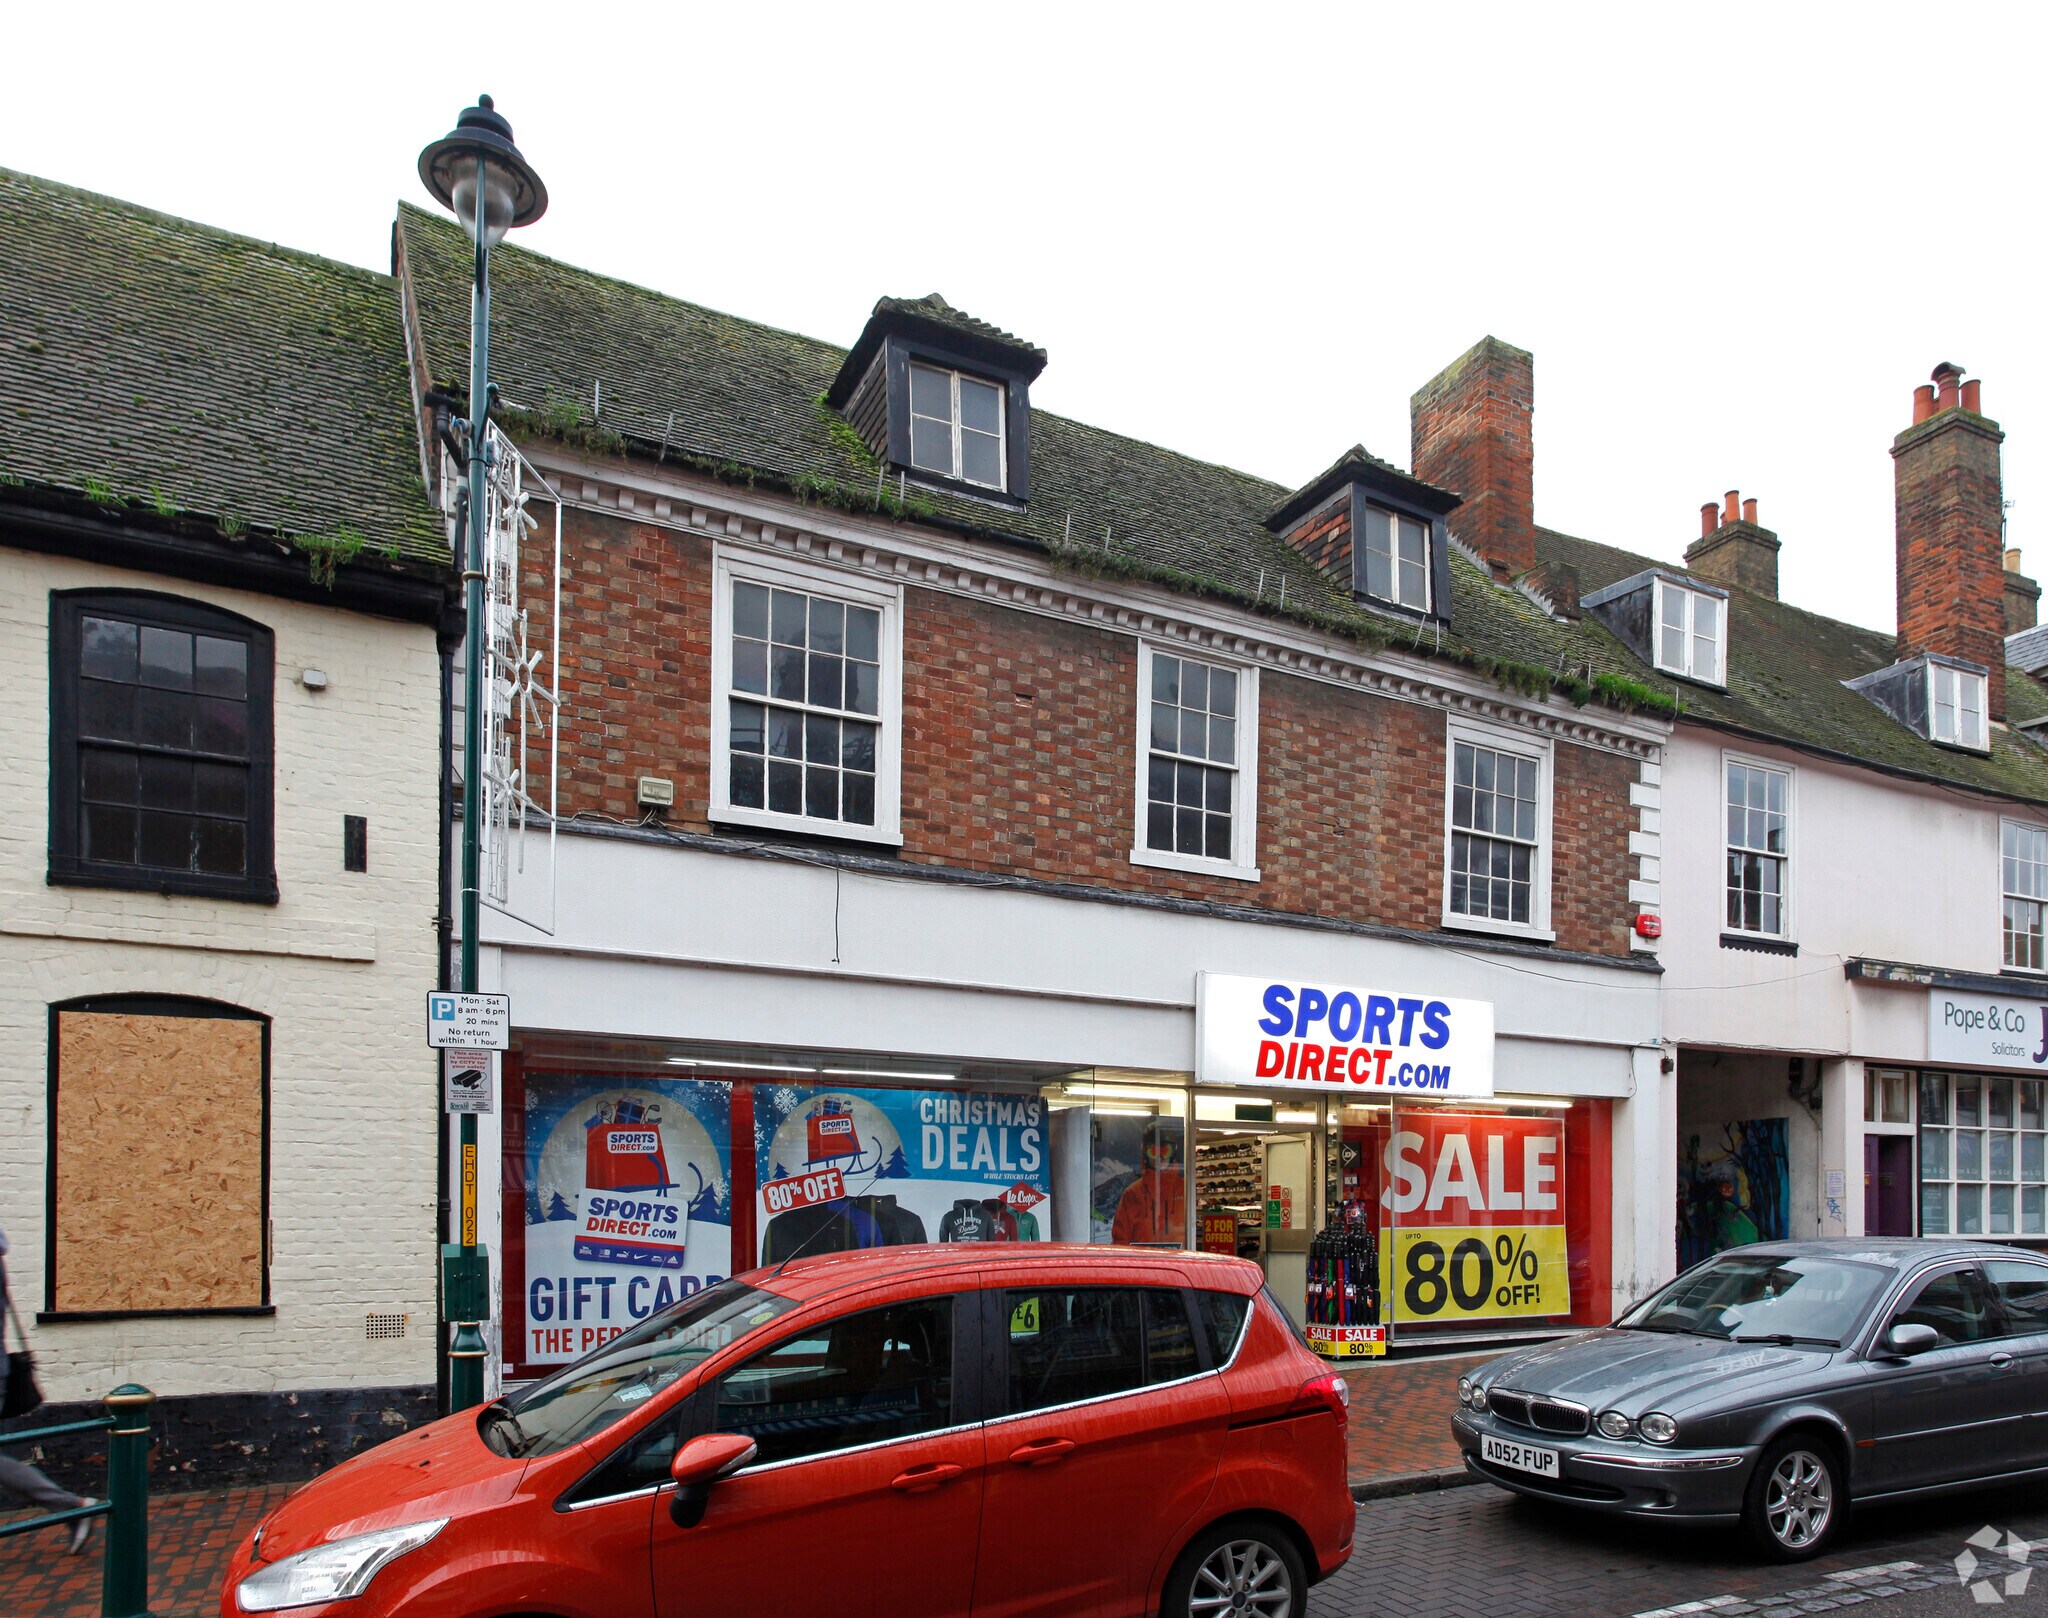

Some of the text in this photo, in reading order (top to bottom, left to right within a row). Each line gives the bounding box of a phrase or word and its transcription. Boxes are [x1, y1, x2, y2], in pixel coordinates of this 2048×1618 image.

[437, 1001, 452, 1018] P
[461, 996, 479, 1004] Mon
[1258, 984, 1451, 1050] SPORTS
[1944, 1001, 2025, 1034] Pope & Co
[464, 1029, 490, 1037] return
[1991, 1041, 2025, 1057] Solicitors
[1255, 1040, 1451, 1089] DIRECT.COM
[920, 1098, 1040, 1127] CHRISTMAS
[821, 1120, 850, 1129] SPORTS
[610, 1133, 655, 1144] SPORTS
[610, 1143, 656, 1151] DIRECT.COM
[922, 1125, 1041, 1172] DEALS
[465, 1146, 474, 1195] EHDT
[983, 1172, 1001, 1180] WHILE
[1380, 1130, 1557, 1213] SALE
[767, 1172, 839, 1211] 80% OFF
[1006, 1190, 1040, 1209] Lee Cooper
[587, 1197, 679, 1224] SPORTS
[953, 1217, 963, 1226] LEE
[586, 1217, 677, 1239] DIRECT.COM
[1205, 1220, 1233, 1233] 2 FOR
[1205, 1233, 1234, 1243] OFFERS
[1404, 1233, 1539, 1315] 80%
[530, 1276, 616, 1322] GIFT
[1495, 1284, 1541, 1307] OFF!
[1015, 1304, 1035, 1329] £6
[531, 1327, 573, 1354] THE
[1311, 1327, 1332, 1341] SALE
[1345, 1329, 1378, 1341] SALE
[1349, 1342, 1374, 1354] 80%
[1487, 1440, 1554, 1472] AD52 FUP
